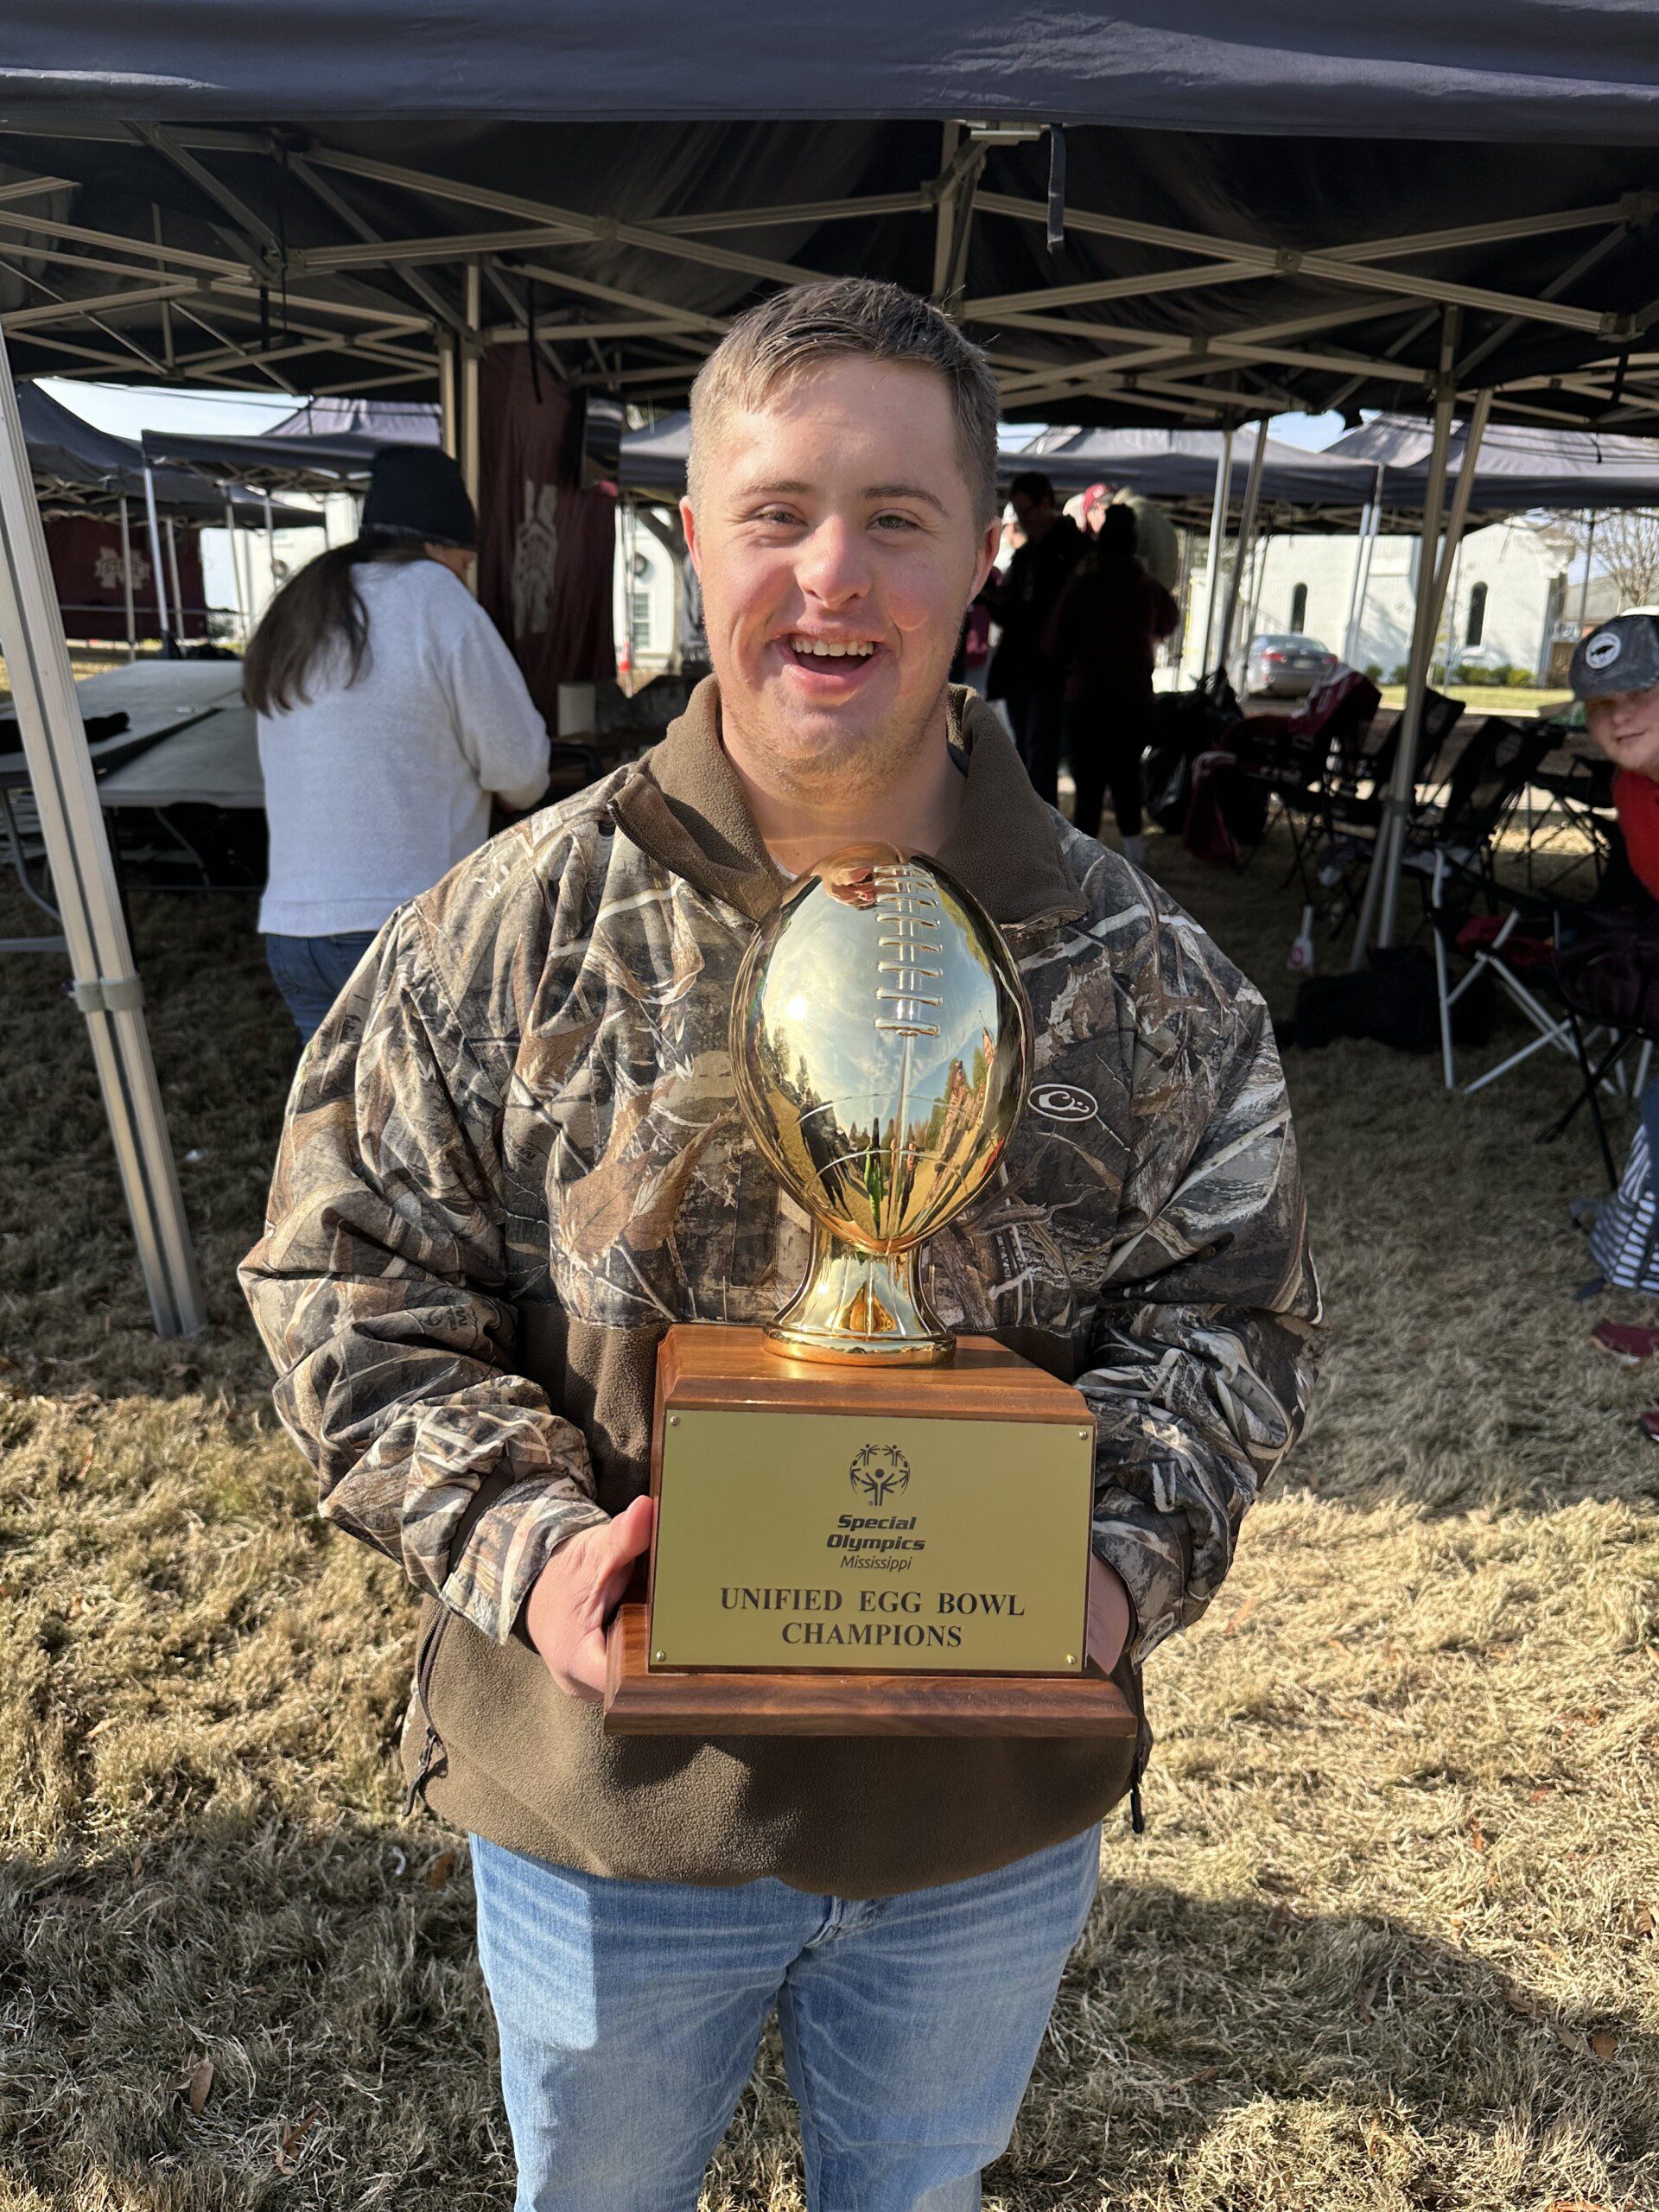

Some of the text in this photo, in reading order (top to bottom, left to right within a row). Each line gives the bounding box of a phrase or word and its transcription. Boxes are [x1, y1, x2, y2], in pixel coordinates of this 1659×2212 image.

[837, 1514, 918, 1532] Special
[826, 1534, 926, 1553] Olympics
[840, 1554, 913, 1573] Mississippi
[720, 1587, 1026, 1616] UNIFIED EGG BOWL
[782, 1621, 963, 1648] CHAMPIONS
